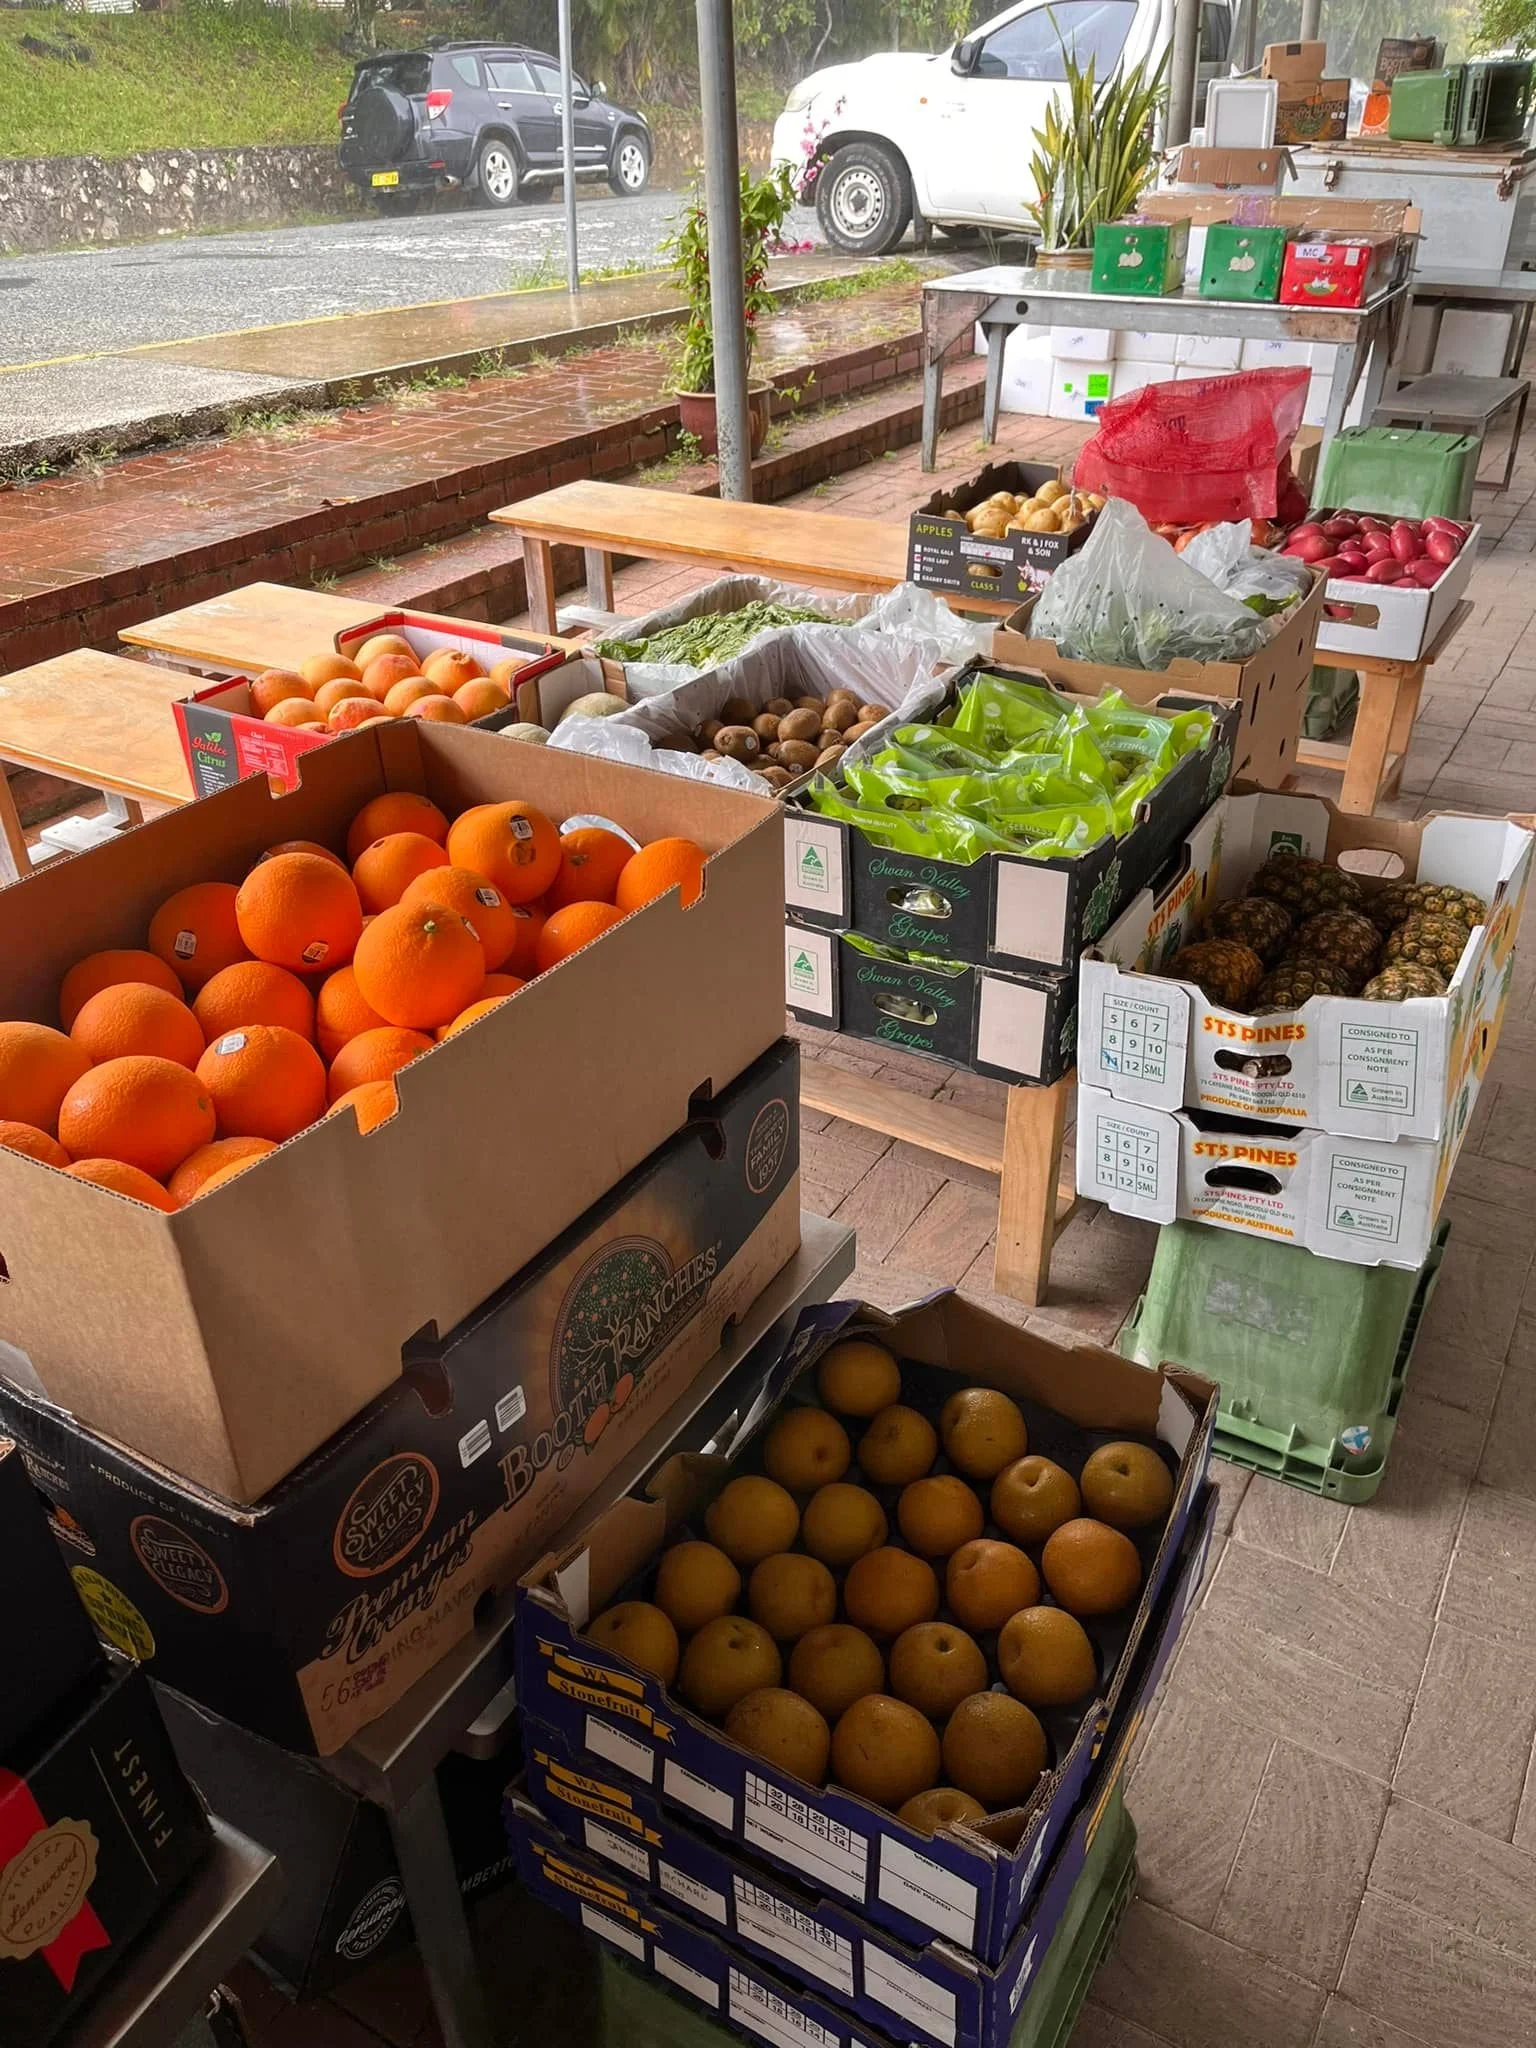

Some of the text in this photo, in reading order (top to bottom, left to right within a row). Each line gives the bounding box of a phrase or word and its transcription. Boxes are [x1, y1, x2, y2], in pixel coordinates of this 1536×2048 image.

[916, 524, 953, 537] APPLES
[1021, 537, 1032, 545] RK
[1045, 540, 1059, 549] FOX
[1035, 548, 1051, 557] SON
[970, 581, 993, 592] CLASS
[868, 857, 971, 900] Swan Valley
[888, 913, 950, 946] Grapes
[1148, 907, 1165, 939] STS
[856, 965, 957, 1008] Swan Valley
[1113, 999, 1128, 1008] SIZE
[1134, 1002, 1160, 1013] COUNT
[875, 1016, 934, 1049] Grapes
[1110, 1014, 1160, 1032] 5 6 7
[1203, 1016, 1305, 1043] STS PINES
[1348, 1028, 1397, 1039] CONSIGNED
[1109, 1035, 1162, 1054] 8 9 10
[1377, 1047, 1392, 1055] PER
[1125, 1060, 1139, 1071] 12
[1144, 1064, 1162, 1076] SML
[1347, 1054, 1408, 1066] CONSIGNMENT
[1367, 1065, 1389, 1073] NOTE
[1212, 1072, 1229, 1080] STS
[1257, 1081, 1274, 1089] PTY
[1277, 1081, 1294, 1089] LTD
[1200, 1094, 1307, 1117] PRODUCE OF AUSTRALIA
[1371, 1094, 1403, 1103] Australia
[1107, 1121, 1120, 1129] SIZE
[1126, 1126, 1150, 1137] COUNT
[750, 1120, 785, 1171] FAMILY
[1104, 1135, 1151, 1154] 5 6 7
[1194, 1142, 1297, 1166] STS PINES
[1104, 1153, 1154, 1174] 8 9 10
[1339, 1159, 1386, 1173] CONSIGNED
[1100, 1172, 1155, 1193] 11 12 SML
[1337, 1182, 1396, 1198] CONSIGNMENT
[1366, 1179, 1381, 1187] PER
[1219, 1191, 1247, 1201] PINES
[1249, 1196, 1266, 1204] PTY
[1267, 1200, 1284, 1209] LTD
[1355, 1193, 1376, 1203] NOTE
[1192, 1208, 1232, 1221] PRODUCE
[1246, 1220, 1294, 1236] AUSTRALIA
[613, 1245, 718, 1372] RANCHES
[498, 1362, 608, 1513] BOOTH
[97, 1465, 156, 1505] PRODUCE
[159, 1501, 176, 1514] OF
[345, 1475, 410, 1552] SWEET
[366, 1473, 425, 1551] LEGACY
[141, 1533, 196, 1567] SWEET
[153, 1562, 213, 1585] LEGACY
[321, 1509, 477, 1660] Premium
[346, 1541, 474, 1664] Oranges
[581, 1666, 609, 1684] WA
[560, 1680, 641, 1719] Stonefruit
[114, 1738, 174, 1849] FINEST
[575, 1775, 600, 1793] WA
[556, 1786, 632, 1825] Stonefruit
[771, 1788, 846, 1835] 32 28 25 23
[771, 1801, 846, 1847] 20 18 16 14
[24, 1871, 81, 1937] QUALITY
[554, 1874, 628, 1915] Stonefruit
